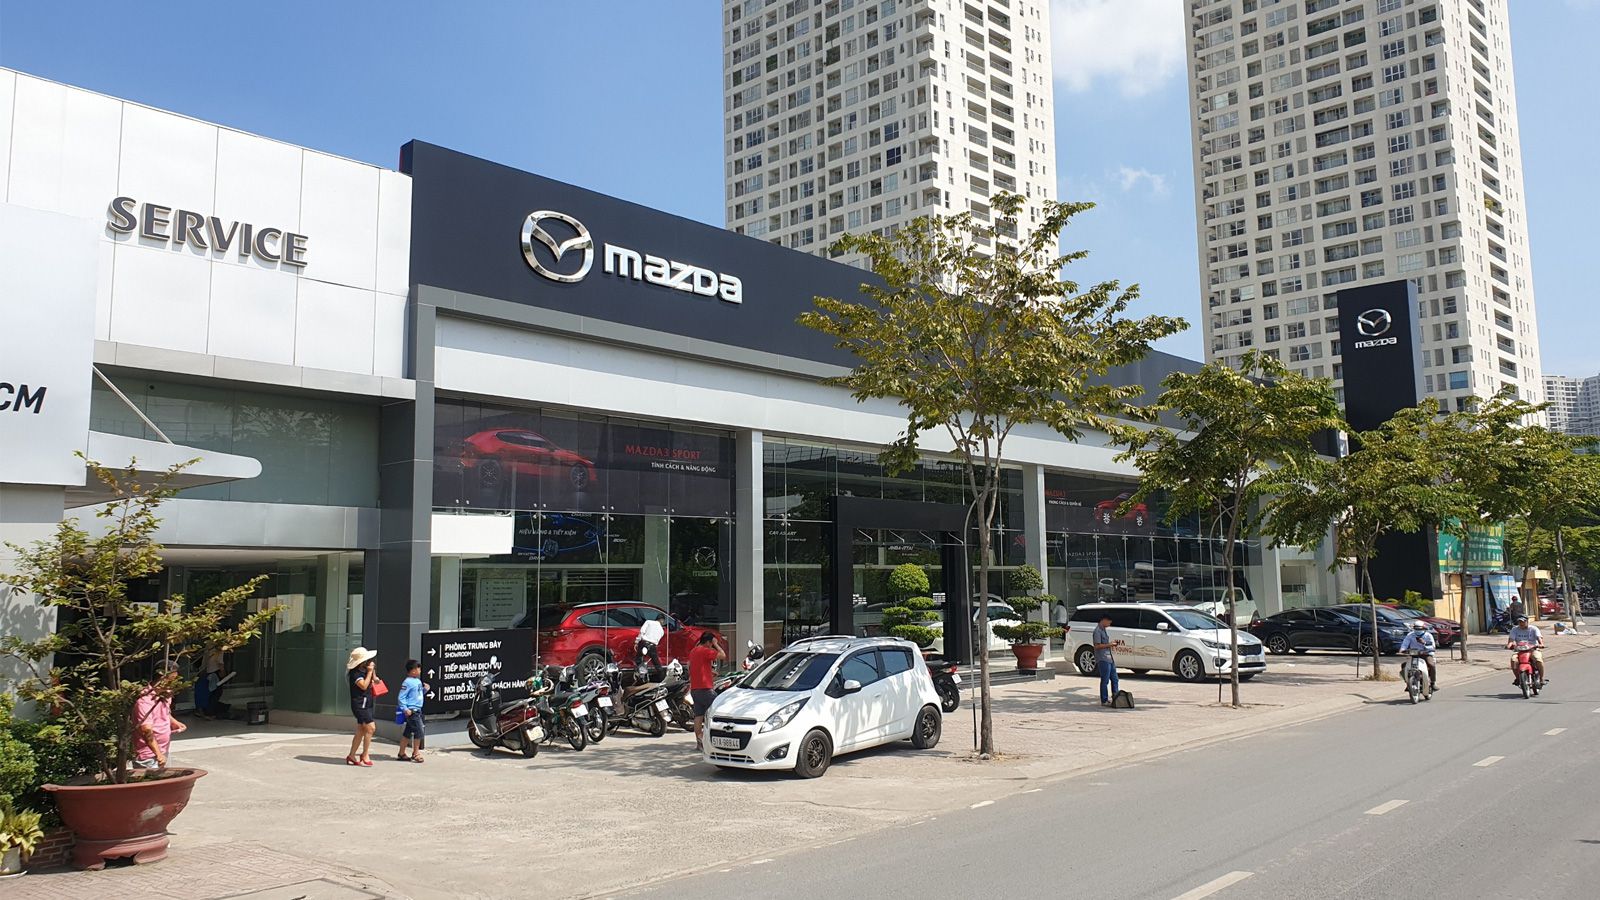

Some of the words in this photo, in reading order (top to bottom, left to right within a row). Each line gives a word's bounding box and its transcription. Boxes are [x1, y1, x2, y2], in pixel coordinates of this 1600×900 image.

[107, 196, 308, 266] SERVICE
[625, 445, 670, 457] MAZDA3
[672, 449, 701, 459] SPORT
[651, 461, 664, 469] TÍNH
[665, 462, 680, 470] CÁCH
[686, 464, 700, 472] NĂNG
[701, 465, 716, 473] ĐỘNG
[444, 642, 467, 651] PHÒNG
[467, 642, 489, 650] TRUNG
[489, 640, 502, 649] BÀY
[444, 651, 472, 659] SHOWROOM
[444, 662, 459, 672] TIẾP
[459, 662, 477, 672] NHẬN
[444, 672, 463, 680] SERVICE
[444, 685, 456, 694] NƠI
[456, 682, 466, 693] ĐỖ
[511, 679, 527, 688] HÀN
[443, 693, 468, 702] CUSTOMER
